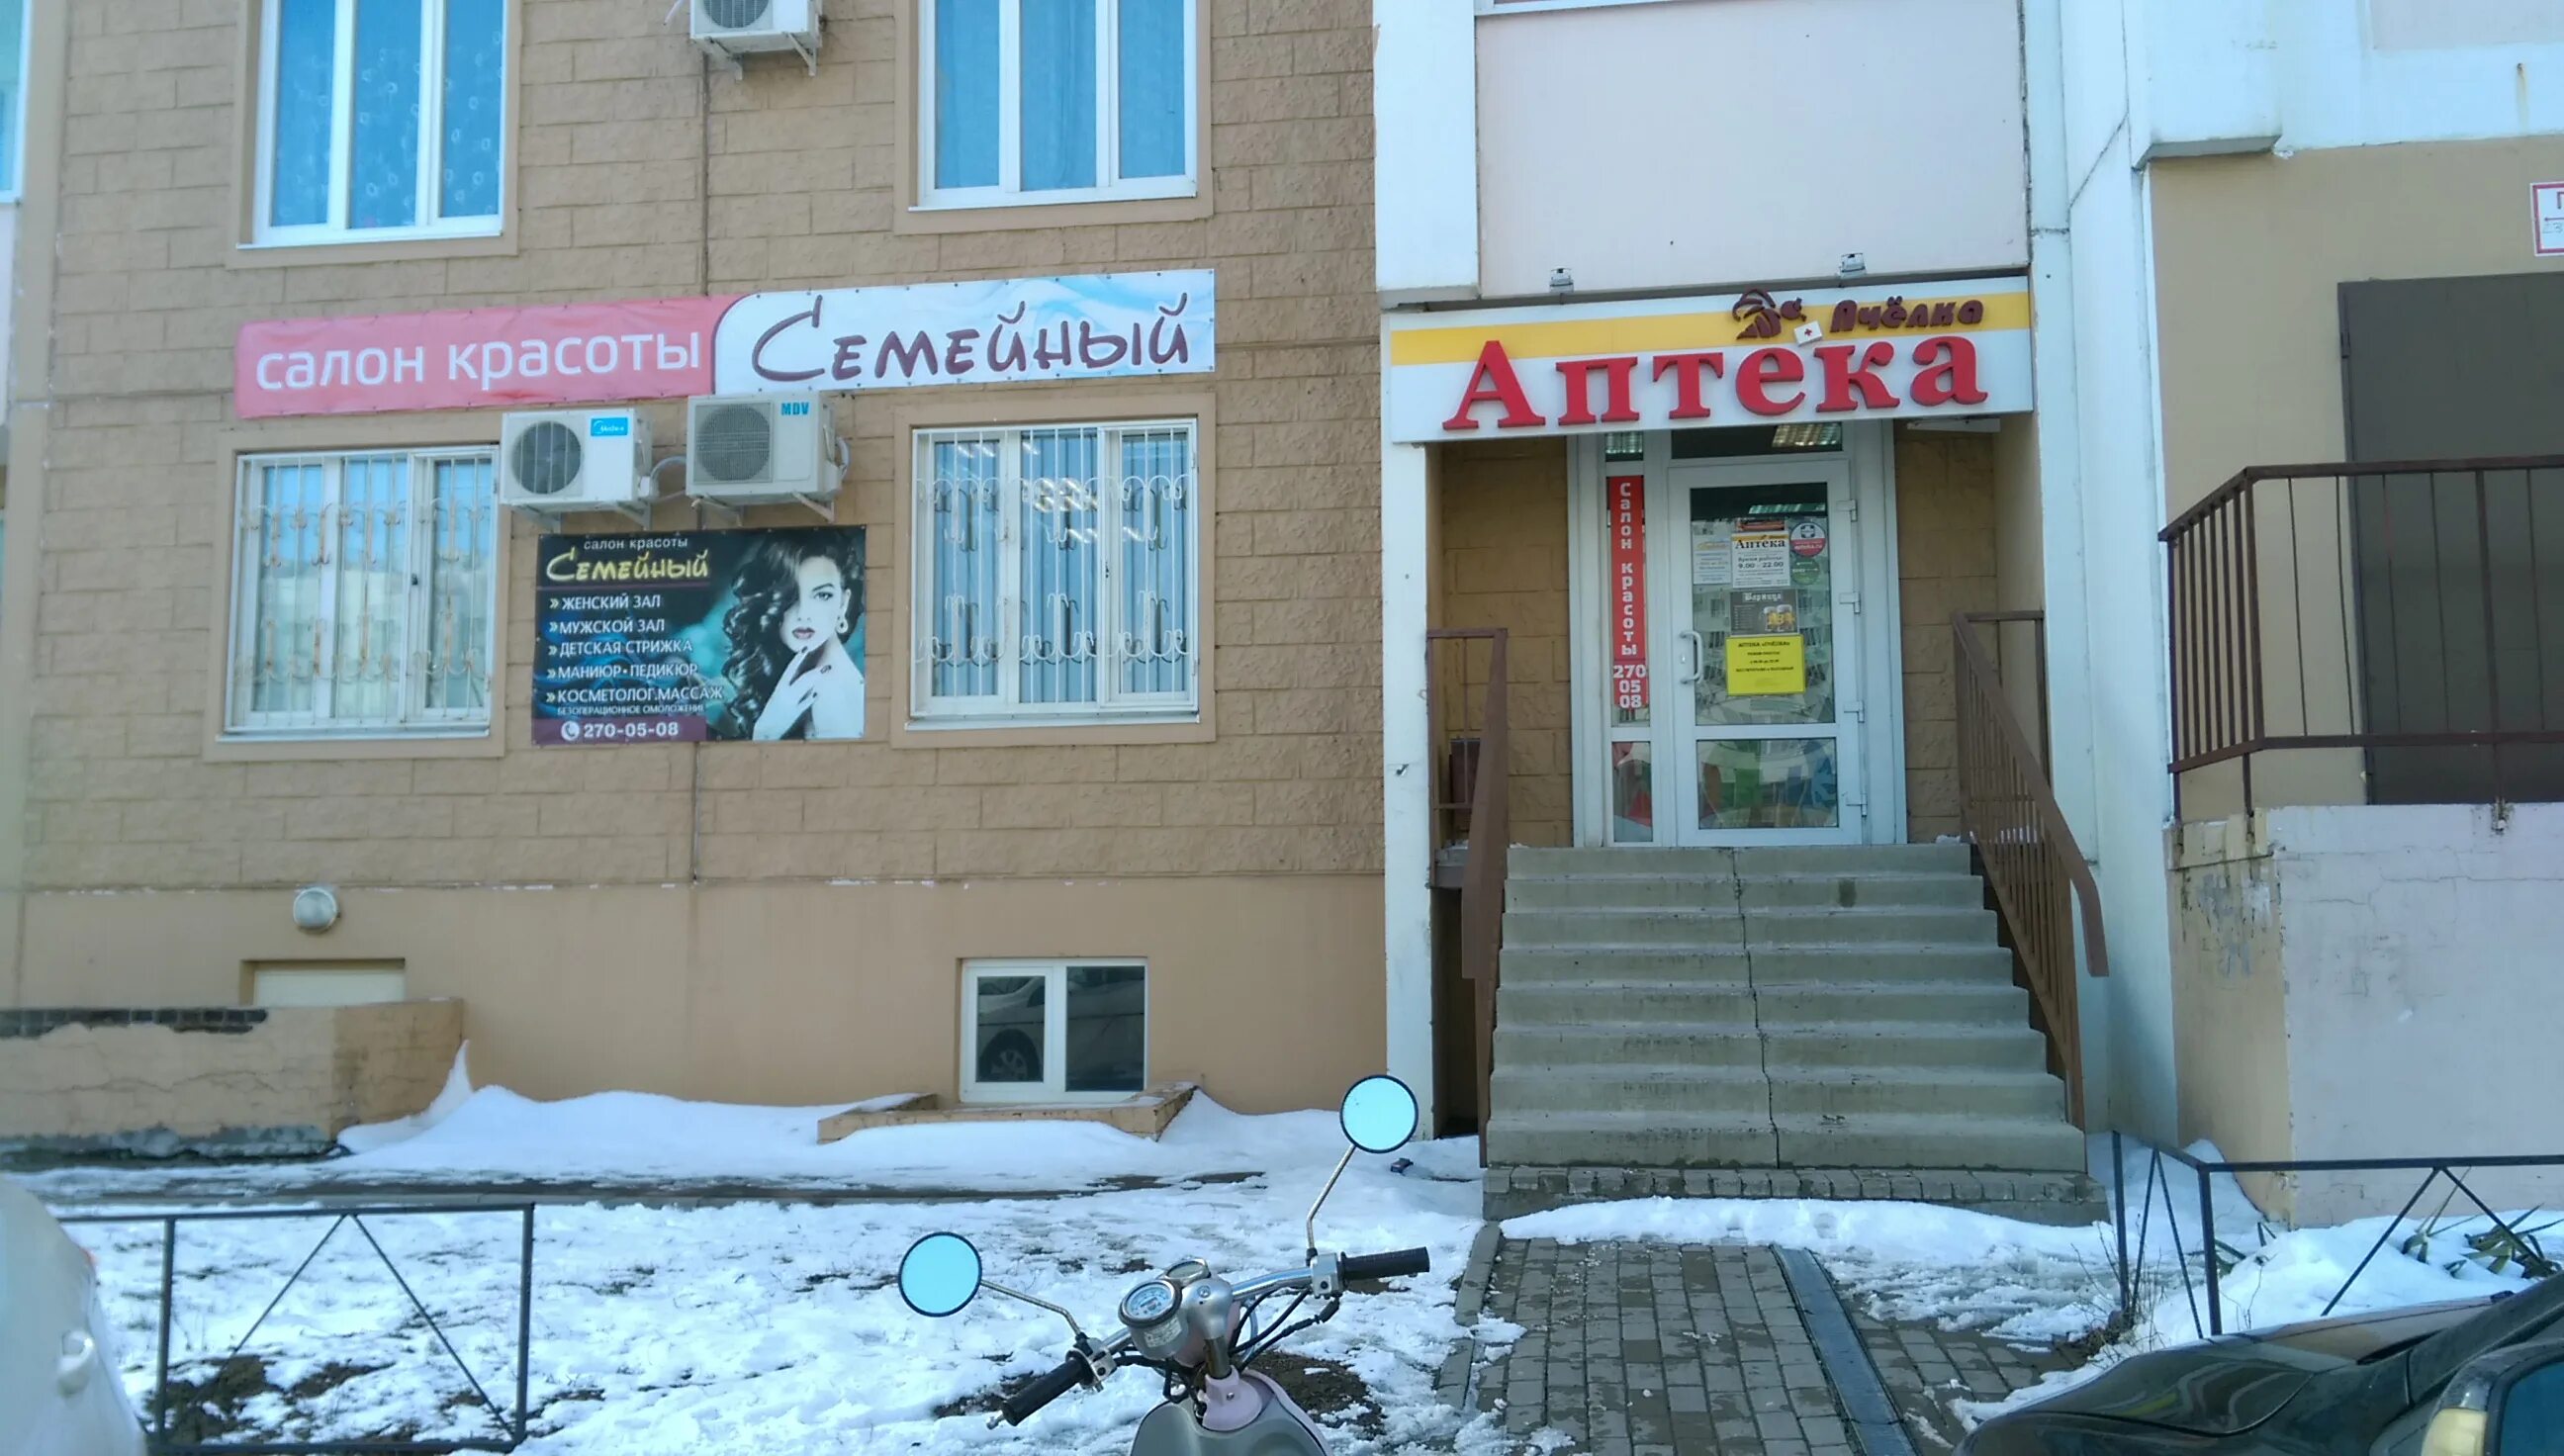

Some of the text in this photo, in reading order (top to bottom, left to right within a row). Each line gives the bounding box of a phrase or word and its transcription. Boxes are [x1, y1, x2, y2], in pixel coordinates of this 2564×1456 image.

[255, 330, 699, 392] салон красоты
[1441, 334, 1989, 432] Аптека
[780, 402, 810, 415] MDV
[584, 537, 688, 551] салон красоты
[1735, 538, 1786, 550] Аптека
[561, 592, 662, 610] ЖЕНСКИЙ ЗАЛ
[559, 616, 666, 635] МУЖСКОЙ ЗАЛ
[559, 639, 693, 658] ДЕТСКАЯ СТРИЖКА
[1612, 664, 1647, 680] 270
[1618, 680, 1642, 693] 05
[1618, 693, 1642, 709] 08
[584, 721, 680, 738] 270-05-08
